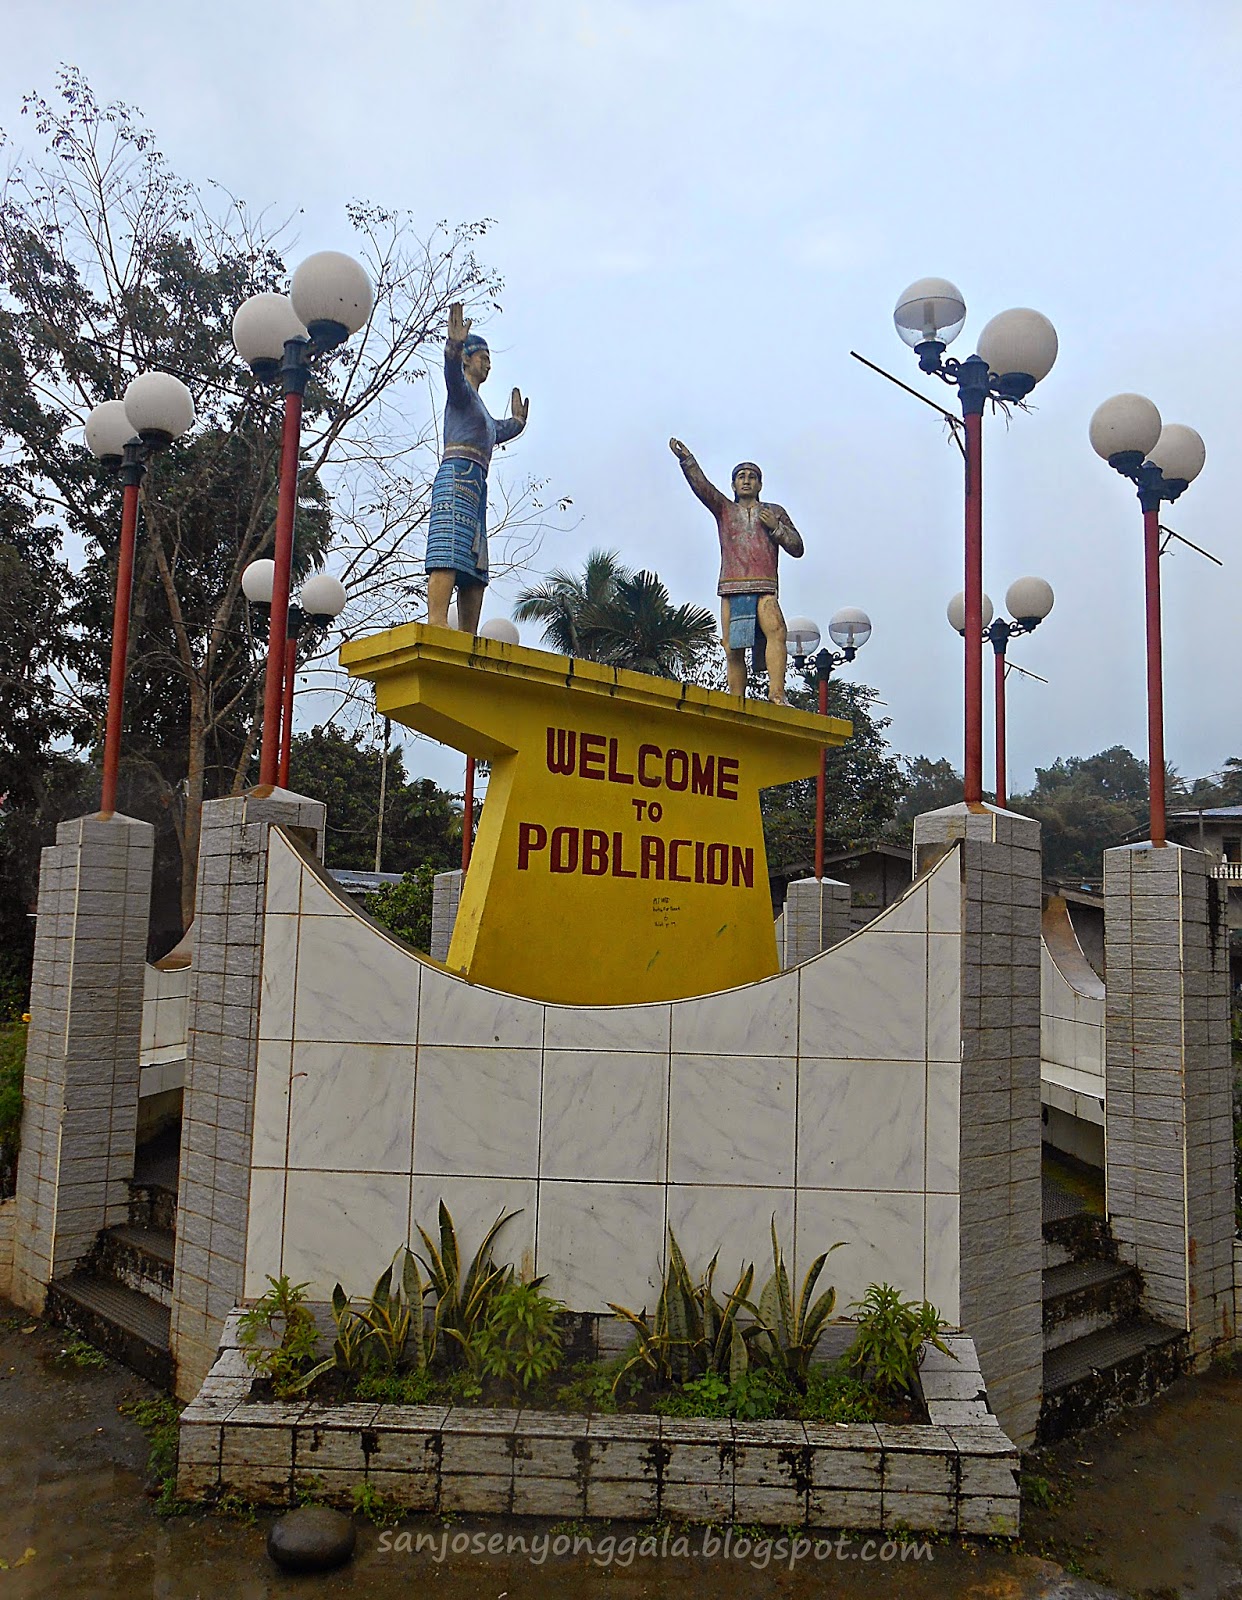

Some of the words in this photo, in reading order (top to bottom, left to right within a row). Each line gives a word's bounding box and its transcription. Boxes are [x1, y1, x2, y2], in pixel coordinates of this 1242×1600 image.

[546, 727, 739, 800] WELCOME
[632, 798, 663, 823] TO
[517, 822, 754, 888] POBLACION
